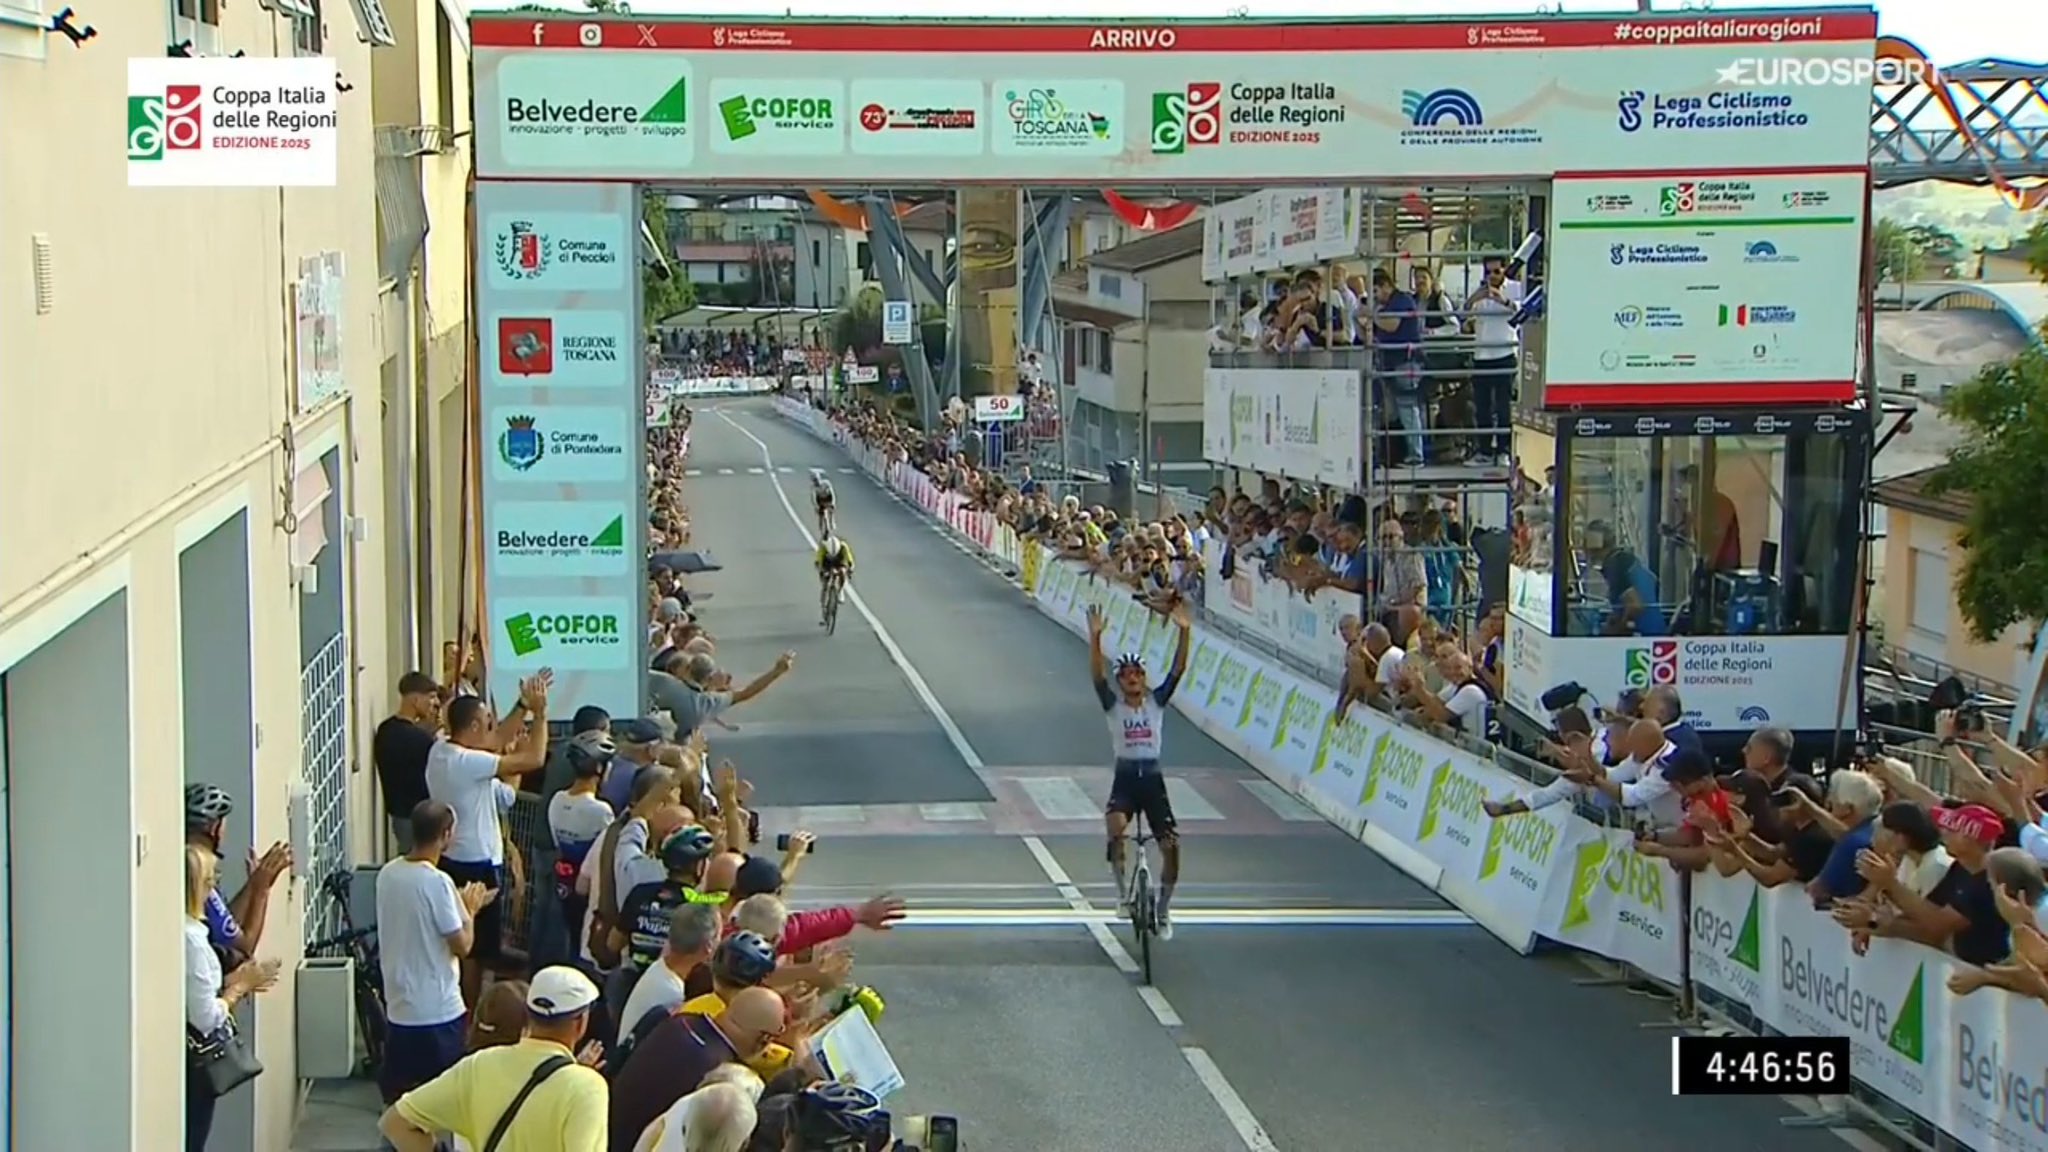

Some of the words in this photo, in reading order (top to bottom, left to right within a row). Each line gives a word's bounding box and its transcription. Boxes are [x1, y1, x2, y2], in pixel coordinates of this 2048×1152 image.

[1614, 17, 1822, 44] #coppaitaliaregioni
[1089, 29, 1176, 48] ARRIVO
[1230, 84, 1285, 103] Coppa
[1291, 83, 1335, 100] Italia
[1008, 99, 1064, 120] GIRO
[1653, 95, 1701, 112] Lega
[1708, 92, 1792, 109] Ciclismo
[507, 97, 638, 123] Belvedere
[1230, 106, 1273, 123] delle
[1280, 105, 1345, 127] Regioni
[719, 95, 832, 141] ECOFOR
[774, 120, 834, 129] service
[1653, 109, 1808, 129] Professionistico
[509, 124, 573, 135] innovazione
[584, 124, 627, 137] progetti
[642, 124, 687, 137] sviluppo
[1014, 120, 1089, 134] TOSCANA
[1230, 131, 1290, 144] EDIZIONE
[1293, 132, 1320, 144] 2025
[558, 239, 606, 250] Comune
[558, 252, 569, 262] di
[563, 336, 616, 348] REGIONE
[563, 349, 616, 361] TOSCANA
[990, 397, 1009, 410] 50
[551, 431, 599, 442] Comune
[551, 443, 562, 454] di
[564, 443, 622, 455] Pontedera
[498, 530, 589, 548] Belvedere
[505, 612, 617, 656] ECOFOR
[560, 636, 620, 645] service
[1685, 641, 1726, 656] Coppa
[1731, 641, 1765, 654] Italia
[1684, 658, 1719, 671] delle
[1722, 658, 1772, 673] Regioni
[1684, 676, 1729, 685] EDIZIONE
[1488, 720, 1500, 735] 2
[1446, 825, 1472, 848] service
[1509, 864, 1539, 892] service
[1617, 909, 1664, 940] service
[1781, 935, 1888, 1042] Belvedere
